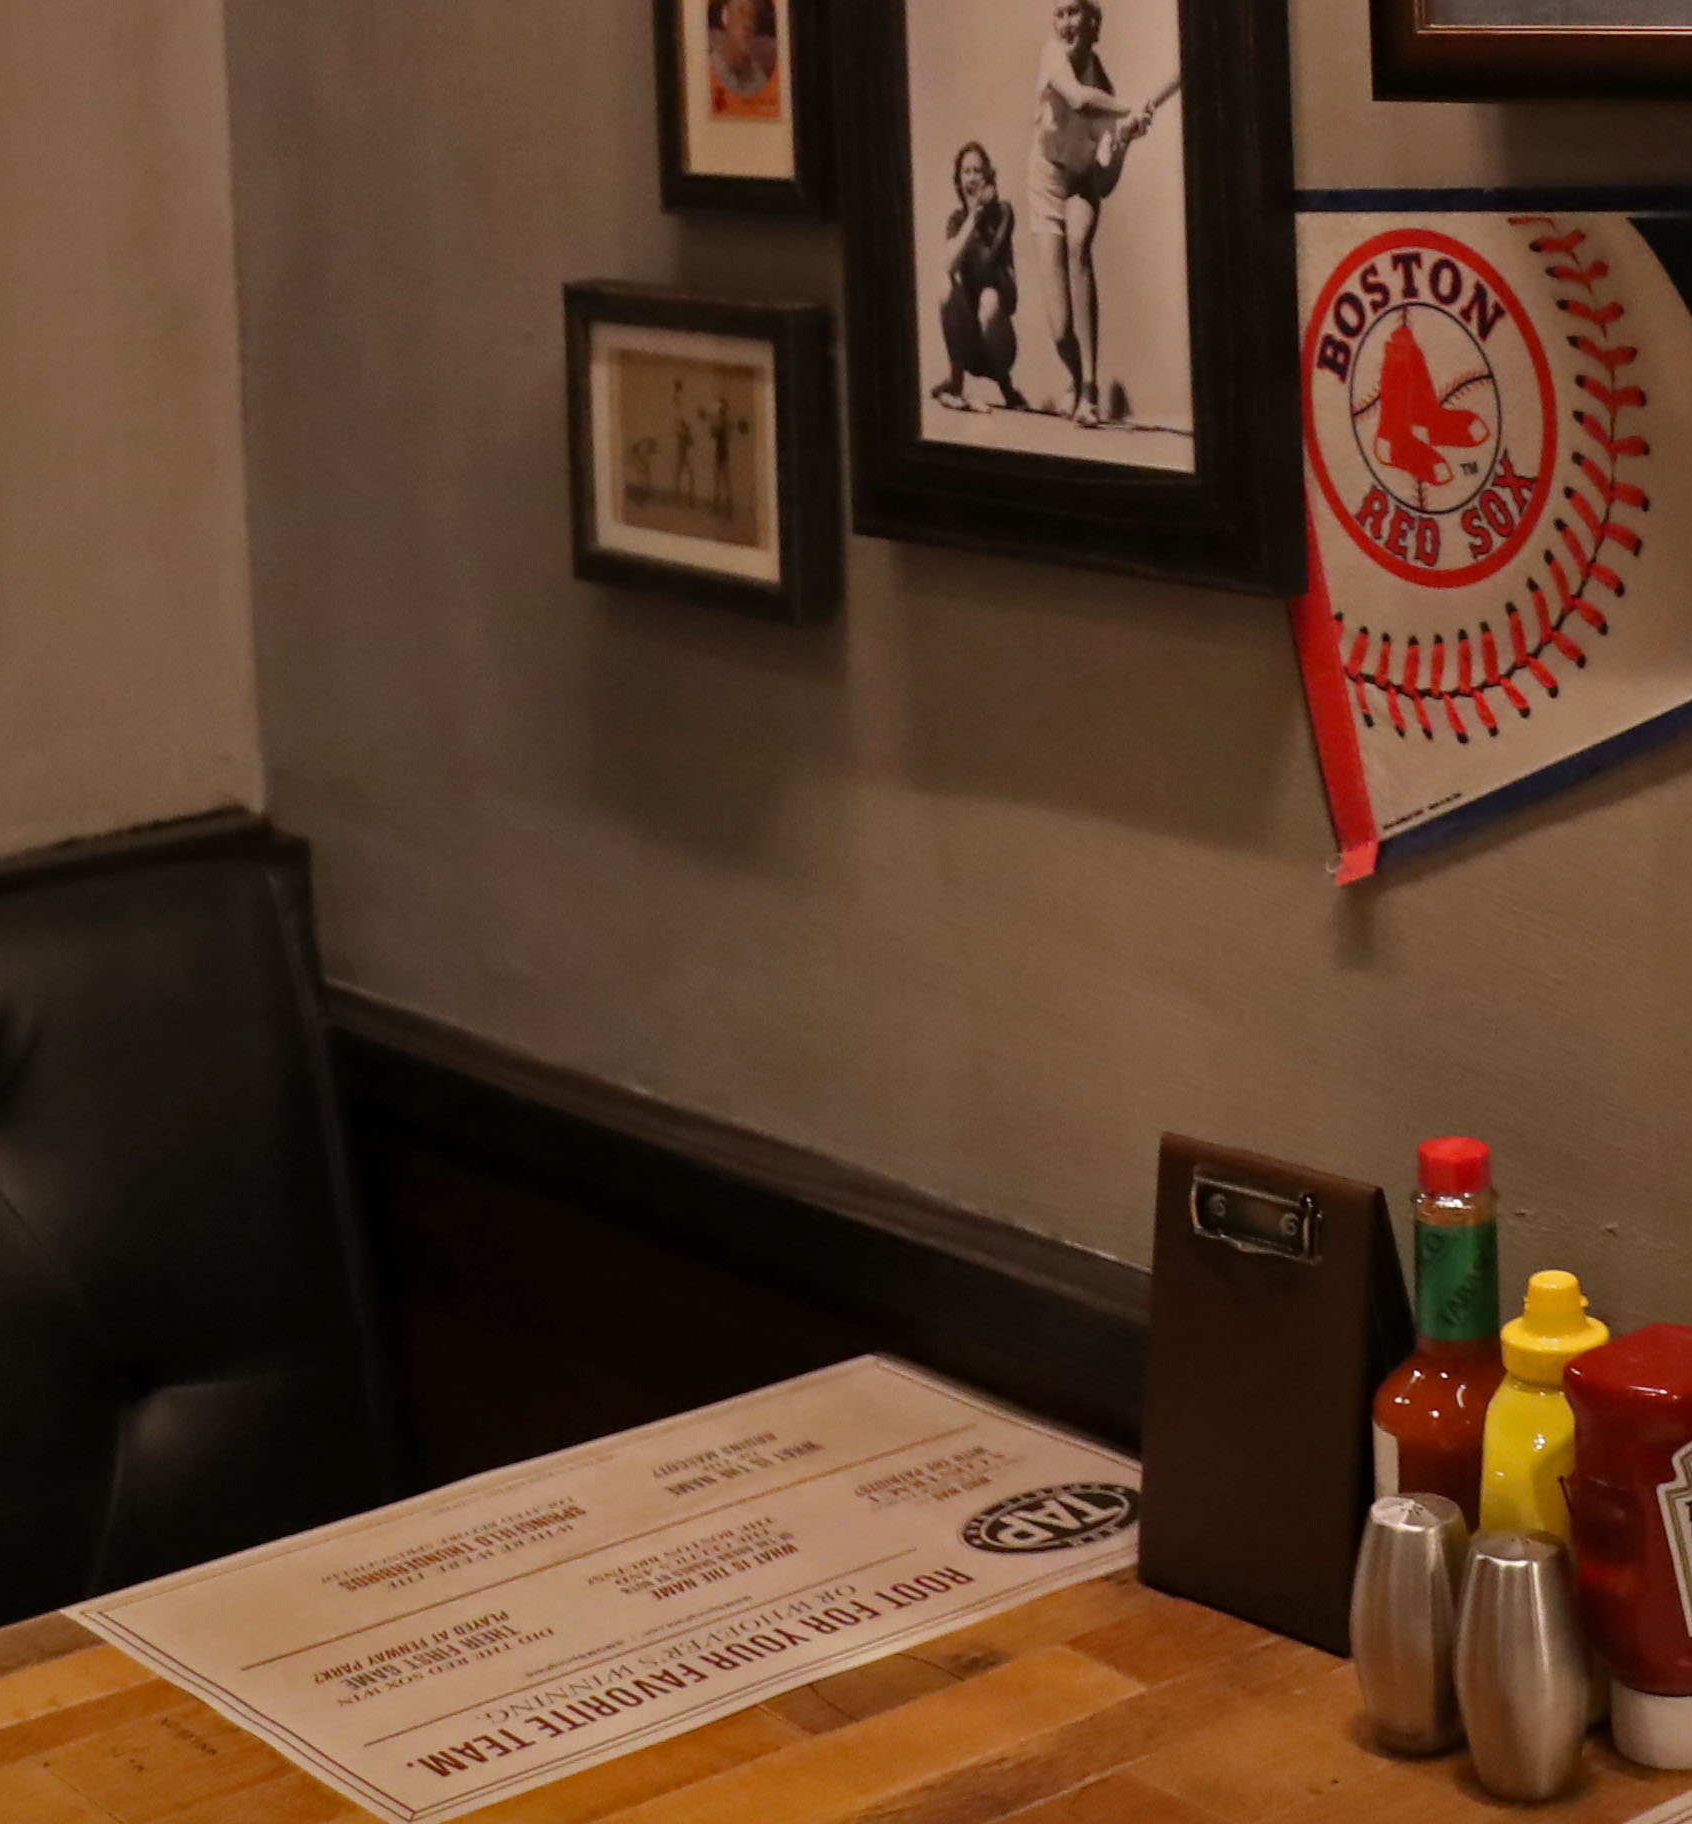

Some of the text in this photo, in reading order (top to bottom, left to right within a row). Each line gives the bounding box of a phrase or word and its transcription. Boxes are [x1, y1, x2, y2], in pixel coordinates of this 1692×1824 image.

[1317, 249, 1506, 382] BOSTON
[1355, 447, 1538, 567] RED SOX
[338, 1506, 586, 1592] SPRINGFIELD THUNDERBIRDS
[997, 1493, 1123, 1549] TAP
[651, 1543, 798, 1600] WHAT IS THE NAME
[815, 1585, 856, 1603] OR
[875, 1567, 975, 1609] ROOT
[453, 1611, 509, 1635] PLAYED
[798, 1601, 881, 1634] FOR
[341, 1625, 521, 1690] THEIR FIRST GAME
[368, 1638, 428, 1666] FENWAY
[699, 1628, 810, 1670] YOUR
[476, 1665, 634, 1723] WINNING.
[524, 1664, 708, 1738] FAVORITE
[406, 1729, 536, 1777] TEAM.
